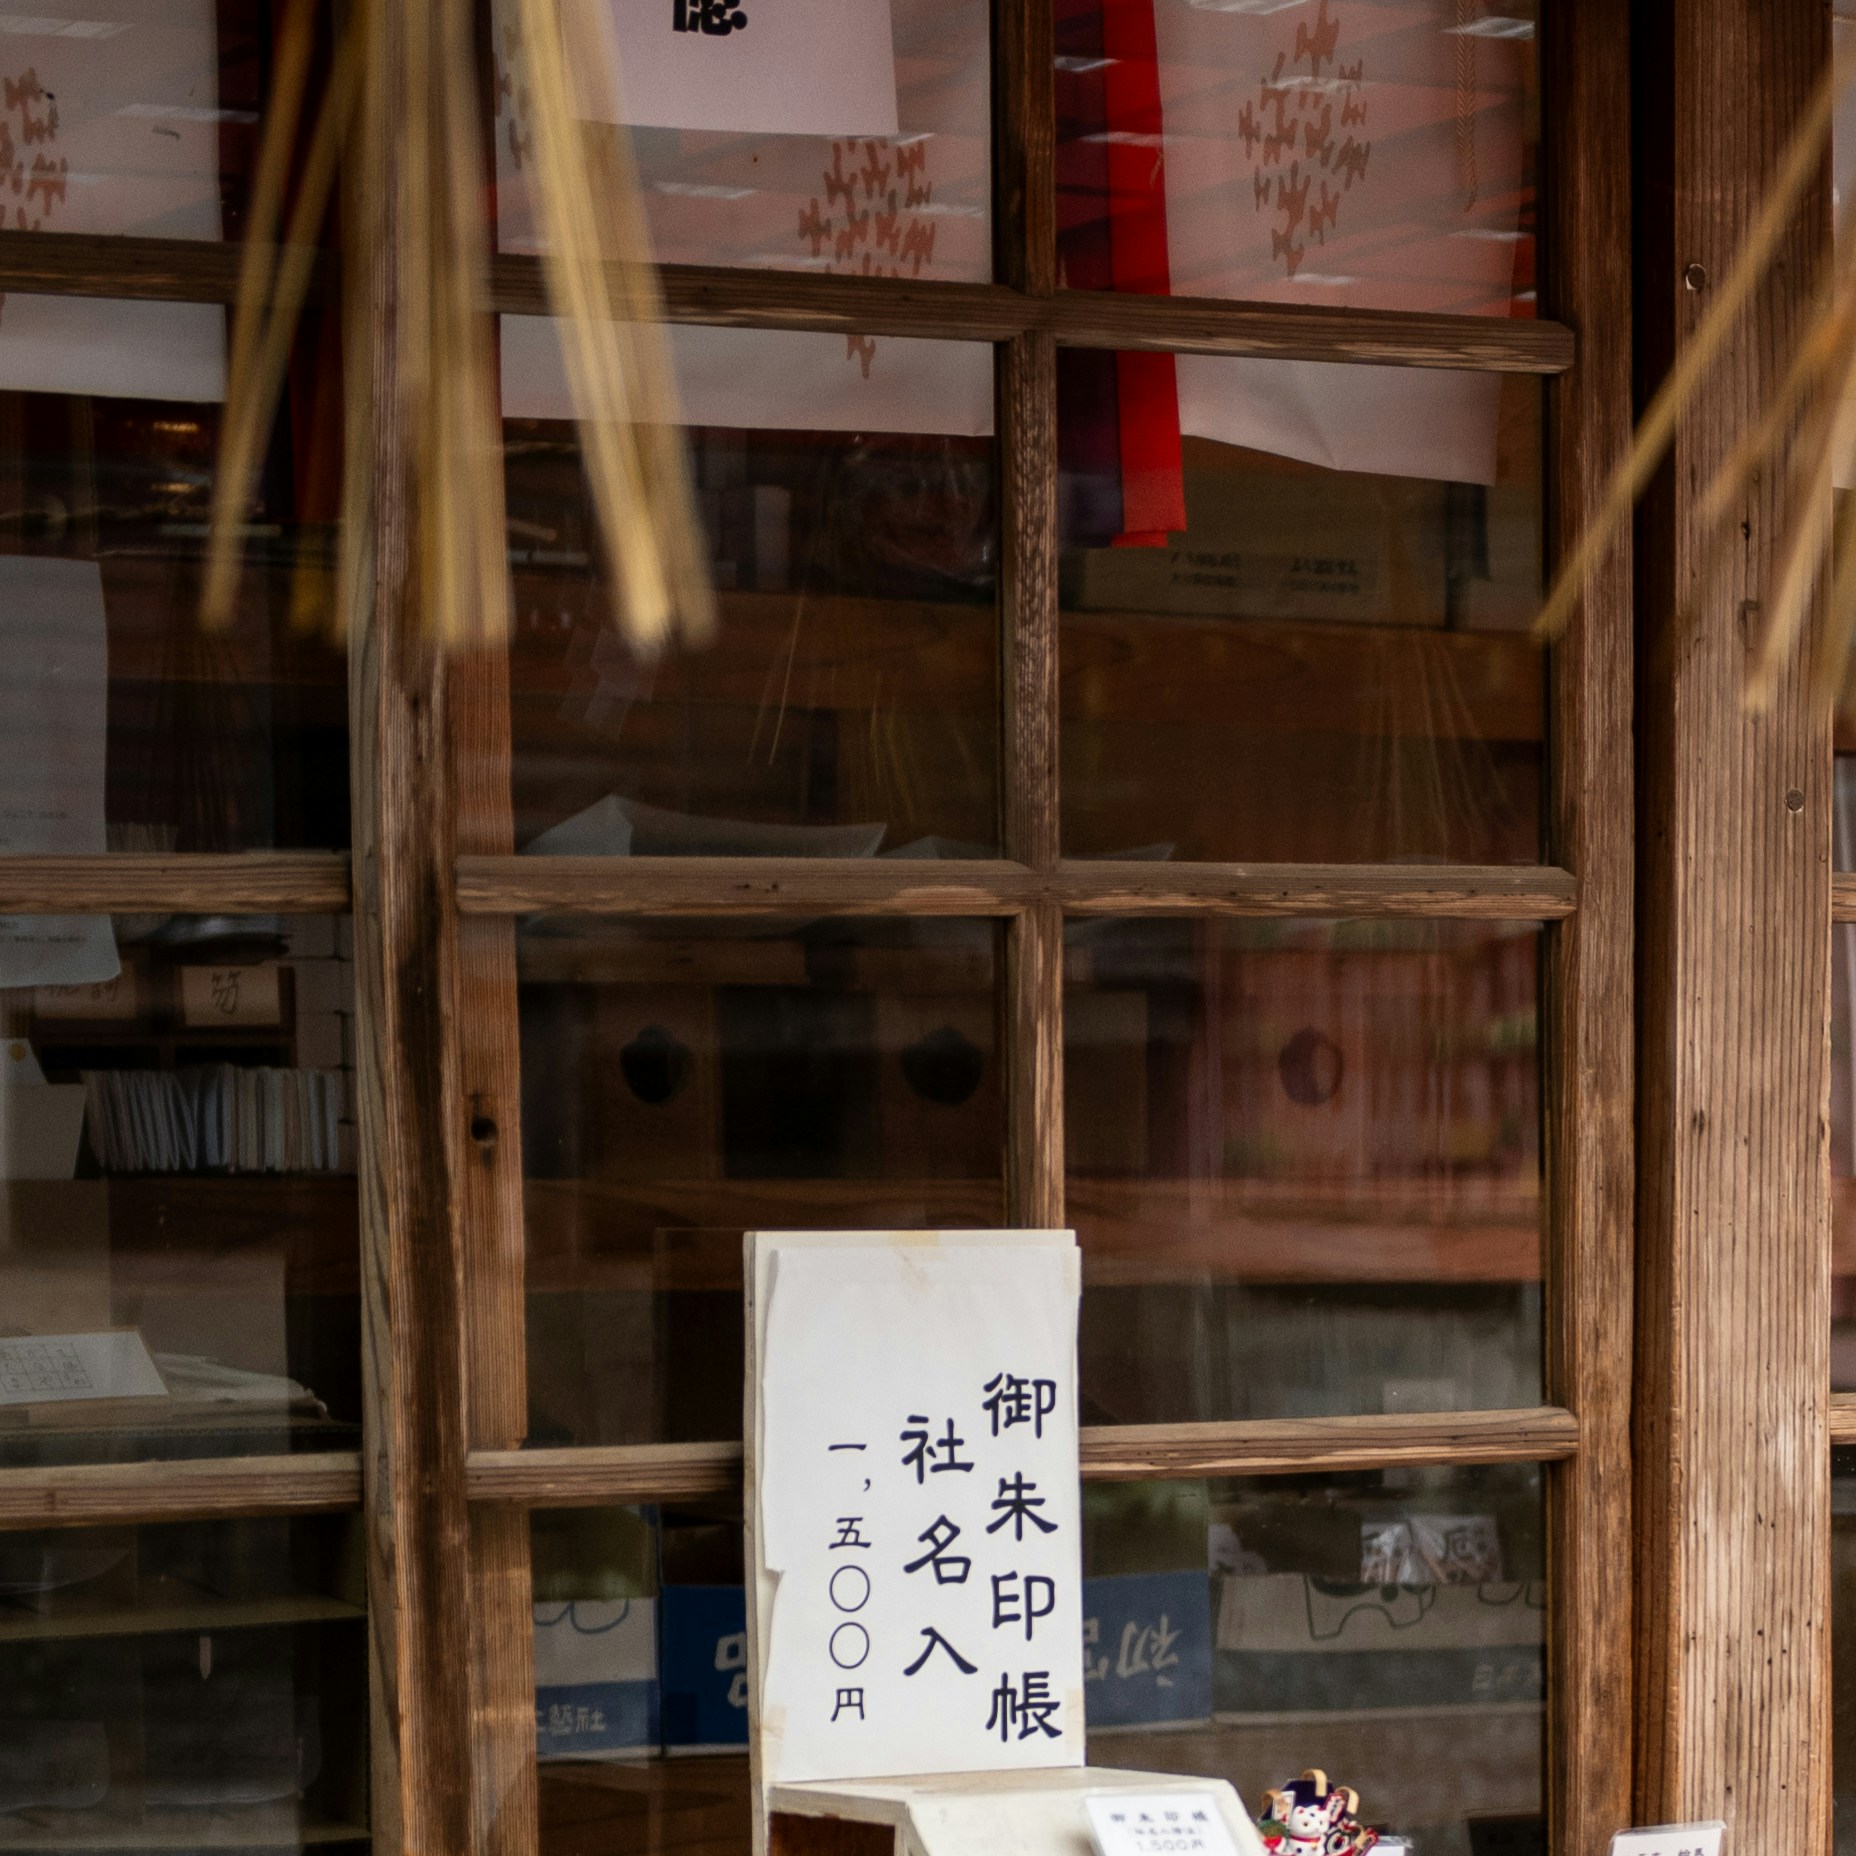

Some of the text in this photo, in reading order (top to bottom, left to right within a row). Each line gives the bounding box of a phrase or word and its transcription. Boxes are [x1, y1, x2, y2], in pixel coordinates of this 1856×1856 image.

[900, 1414, 978, 1678] 社名入
[981, 1372, 1063, 1742] 御朱印帳
